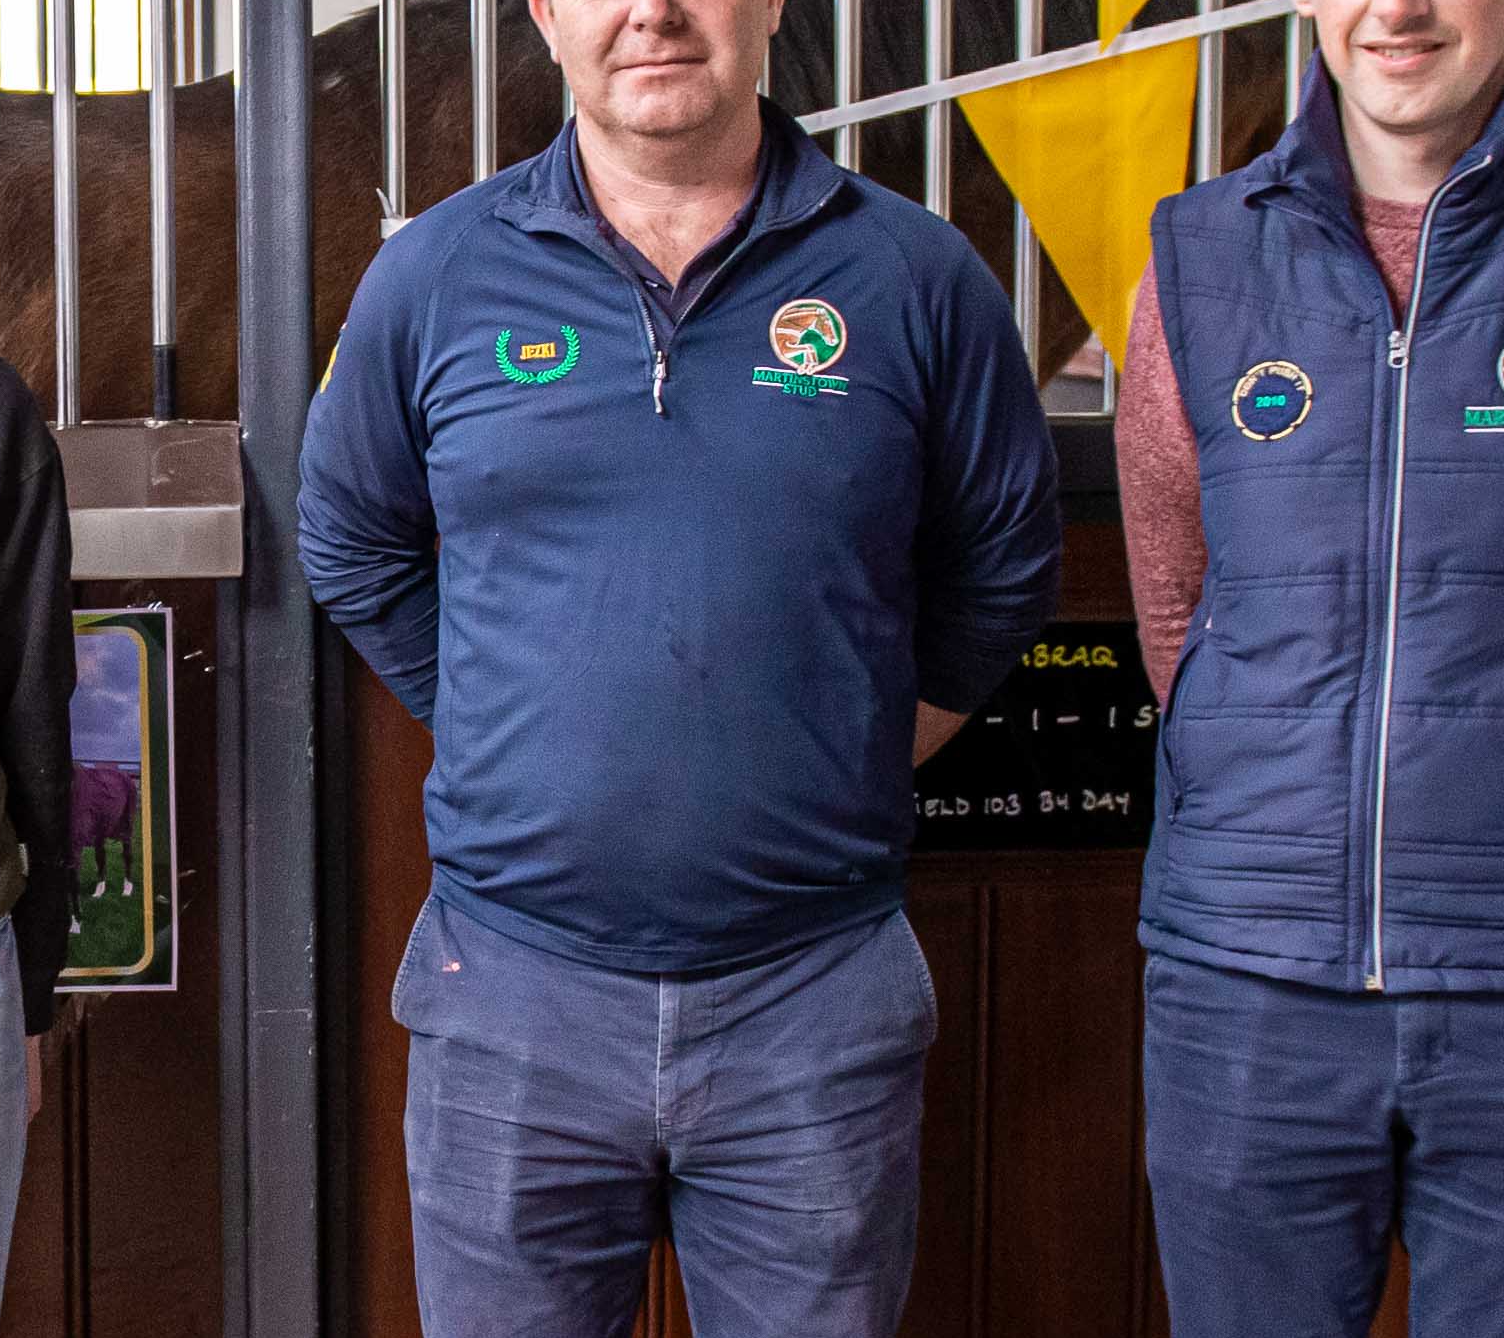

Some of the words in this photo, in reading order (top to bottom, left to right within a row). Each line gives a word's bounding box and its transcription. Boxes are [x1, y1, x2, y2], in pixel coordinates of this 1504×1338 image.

[520, 342, 556, 359] JEZKI
[752, 370, 849, 391] MARTINSTOWN
[783, 383, 817, 397] STUD
[1255, 394, 1286, 409] 2010
[1021, 643, 1118, 668] BRAQ
[913, 792, 970, 817] iELD
[1082, 788, 1130, 815] DAY
